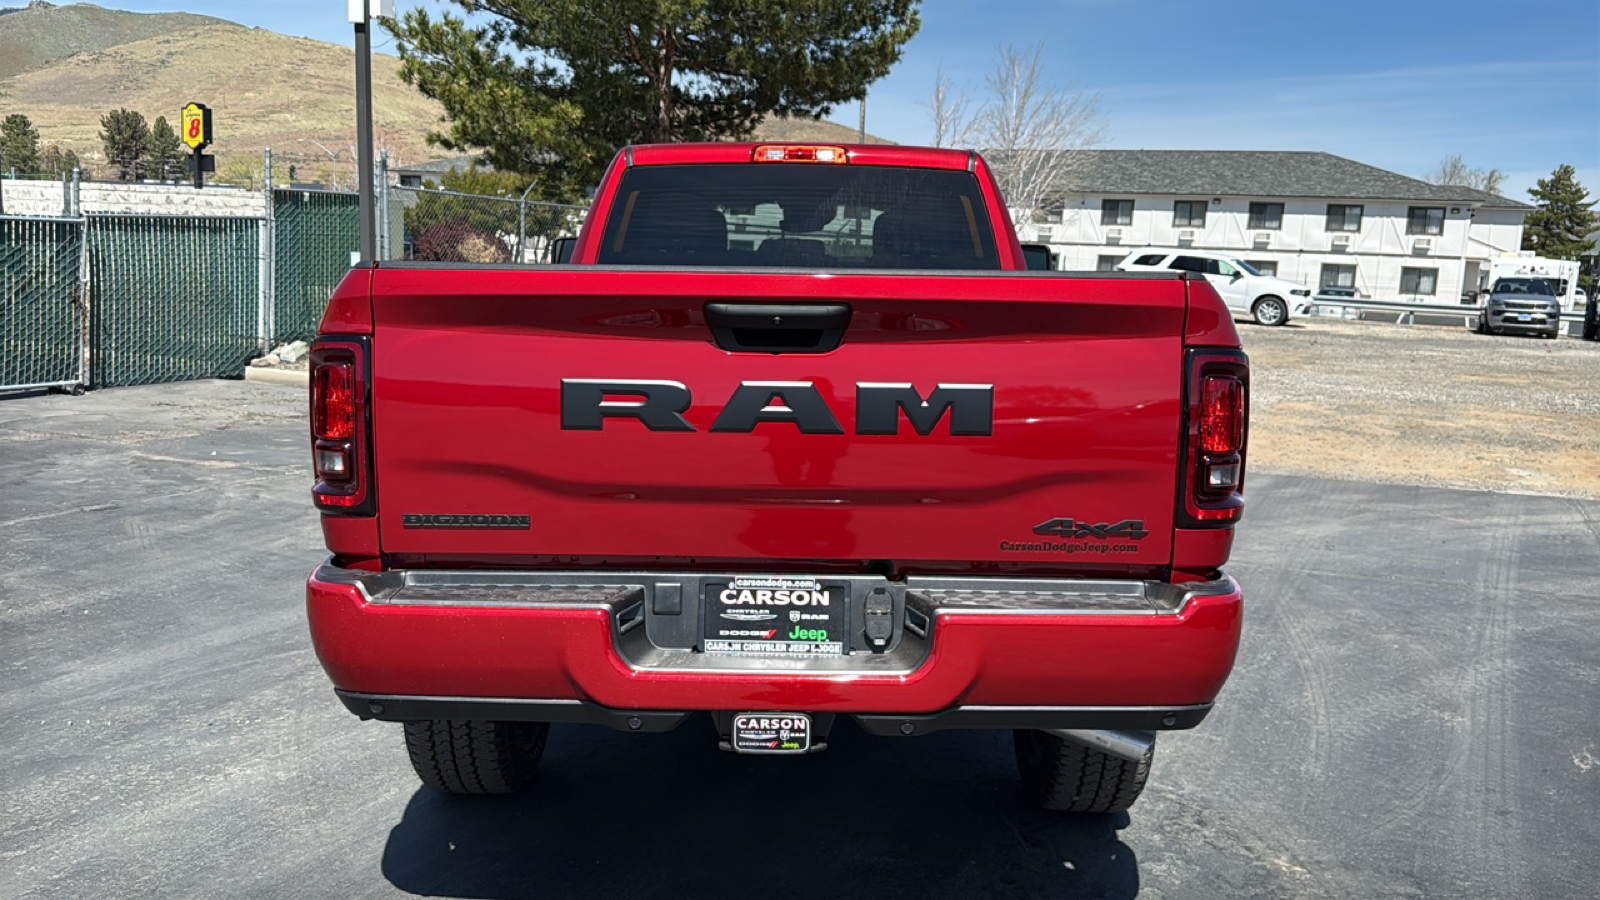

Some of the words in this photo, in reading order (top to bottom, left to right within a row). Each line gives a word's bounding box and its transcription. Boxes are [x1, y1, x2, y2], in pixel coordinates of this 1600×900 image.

[189, 118, 200, 138] 8
[560, 378, 994, 437] RAM
[1032, 517, 1150, 540] 4x4
[1000, 541, 1138, 554] CarsonDodgeJeep.com
[737, 578, 813, 589] carsondodge.com
[720, 589, 830, 606] CARSON
[789, 625, 828, 642] Jeep
[743, 643, 787, 652] CHRYSLER
[789, 643, 810, 652] JEEP
[737, 719, 806, 730] CARSON
